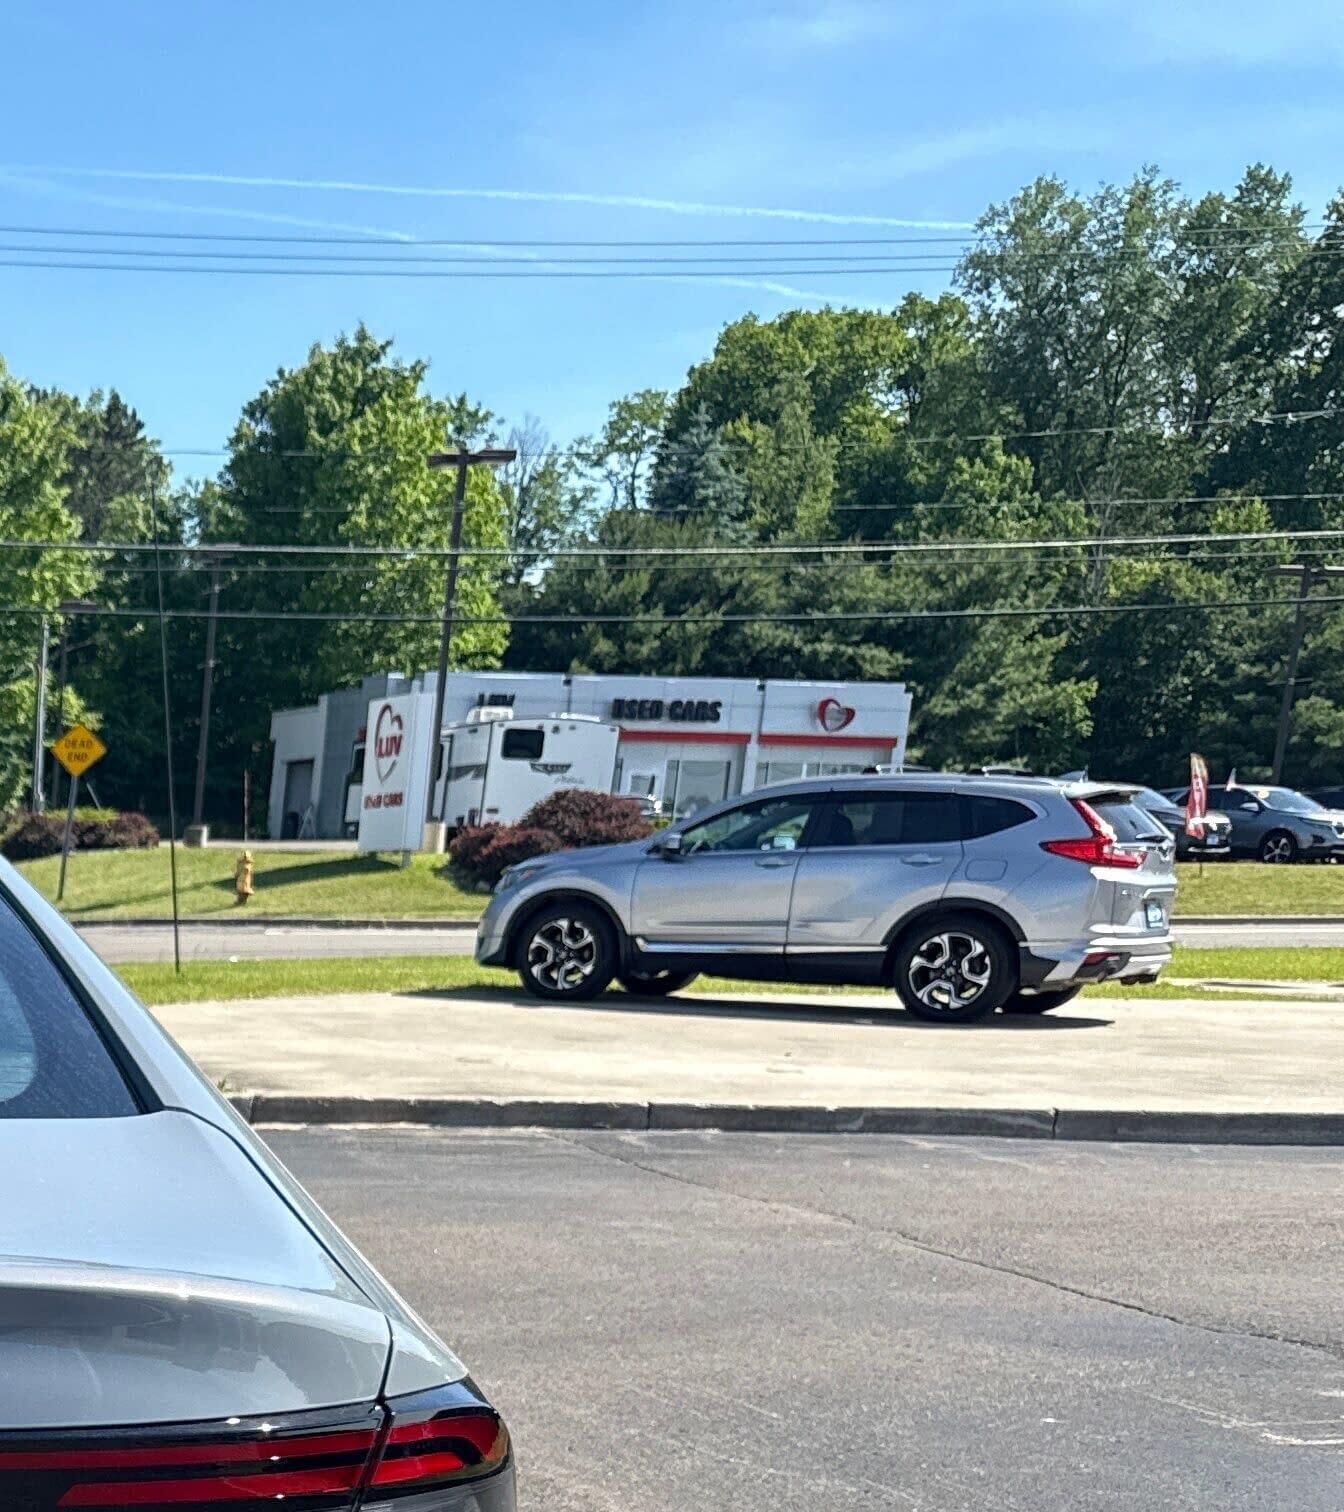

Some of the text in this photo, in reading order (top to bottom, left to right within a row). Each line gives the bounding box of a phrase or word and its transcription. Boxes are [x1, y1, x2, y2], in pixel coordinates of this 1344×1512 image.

[612, 699, 722, 723] USED CARS
[64, 739, 93, 749] DEAD
[377, 735, 403, 758] LUV
[67, 752, 89, 762] END
